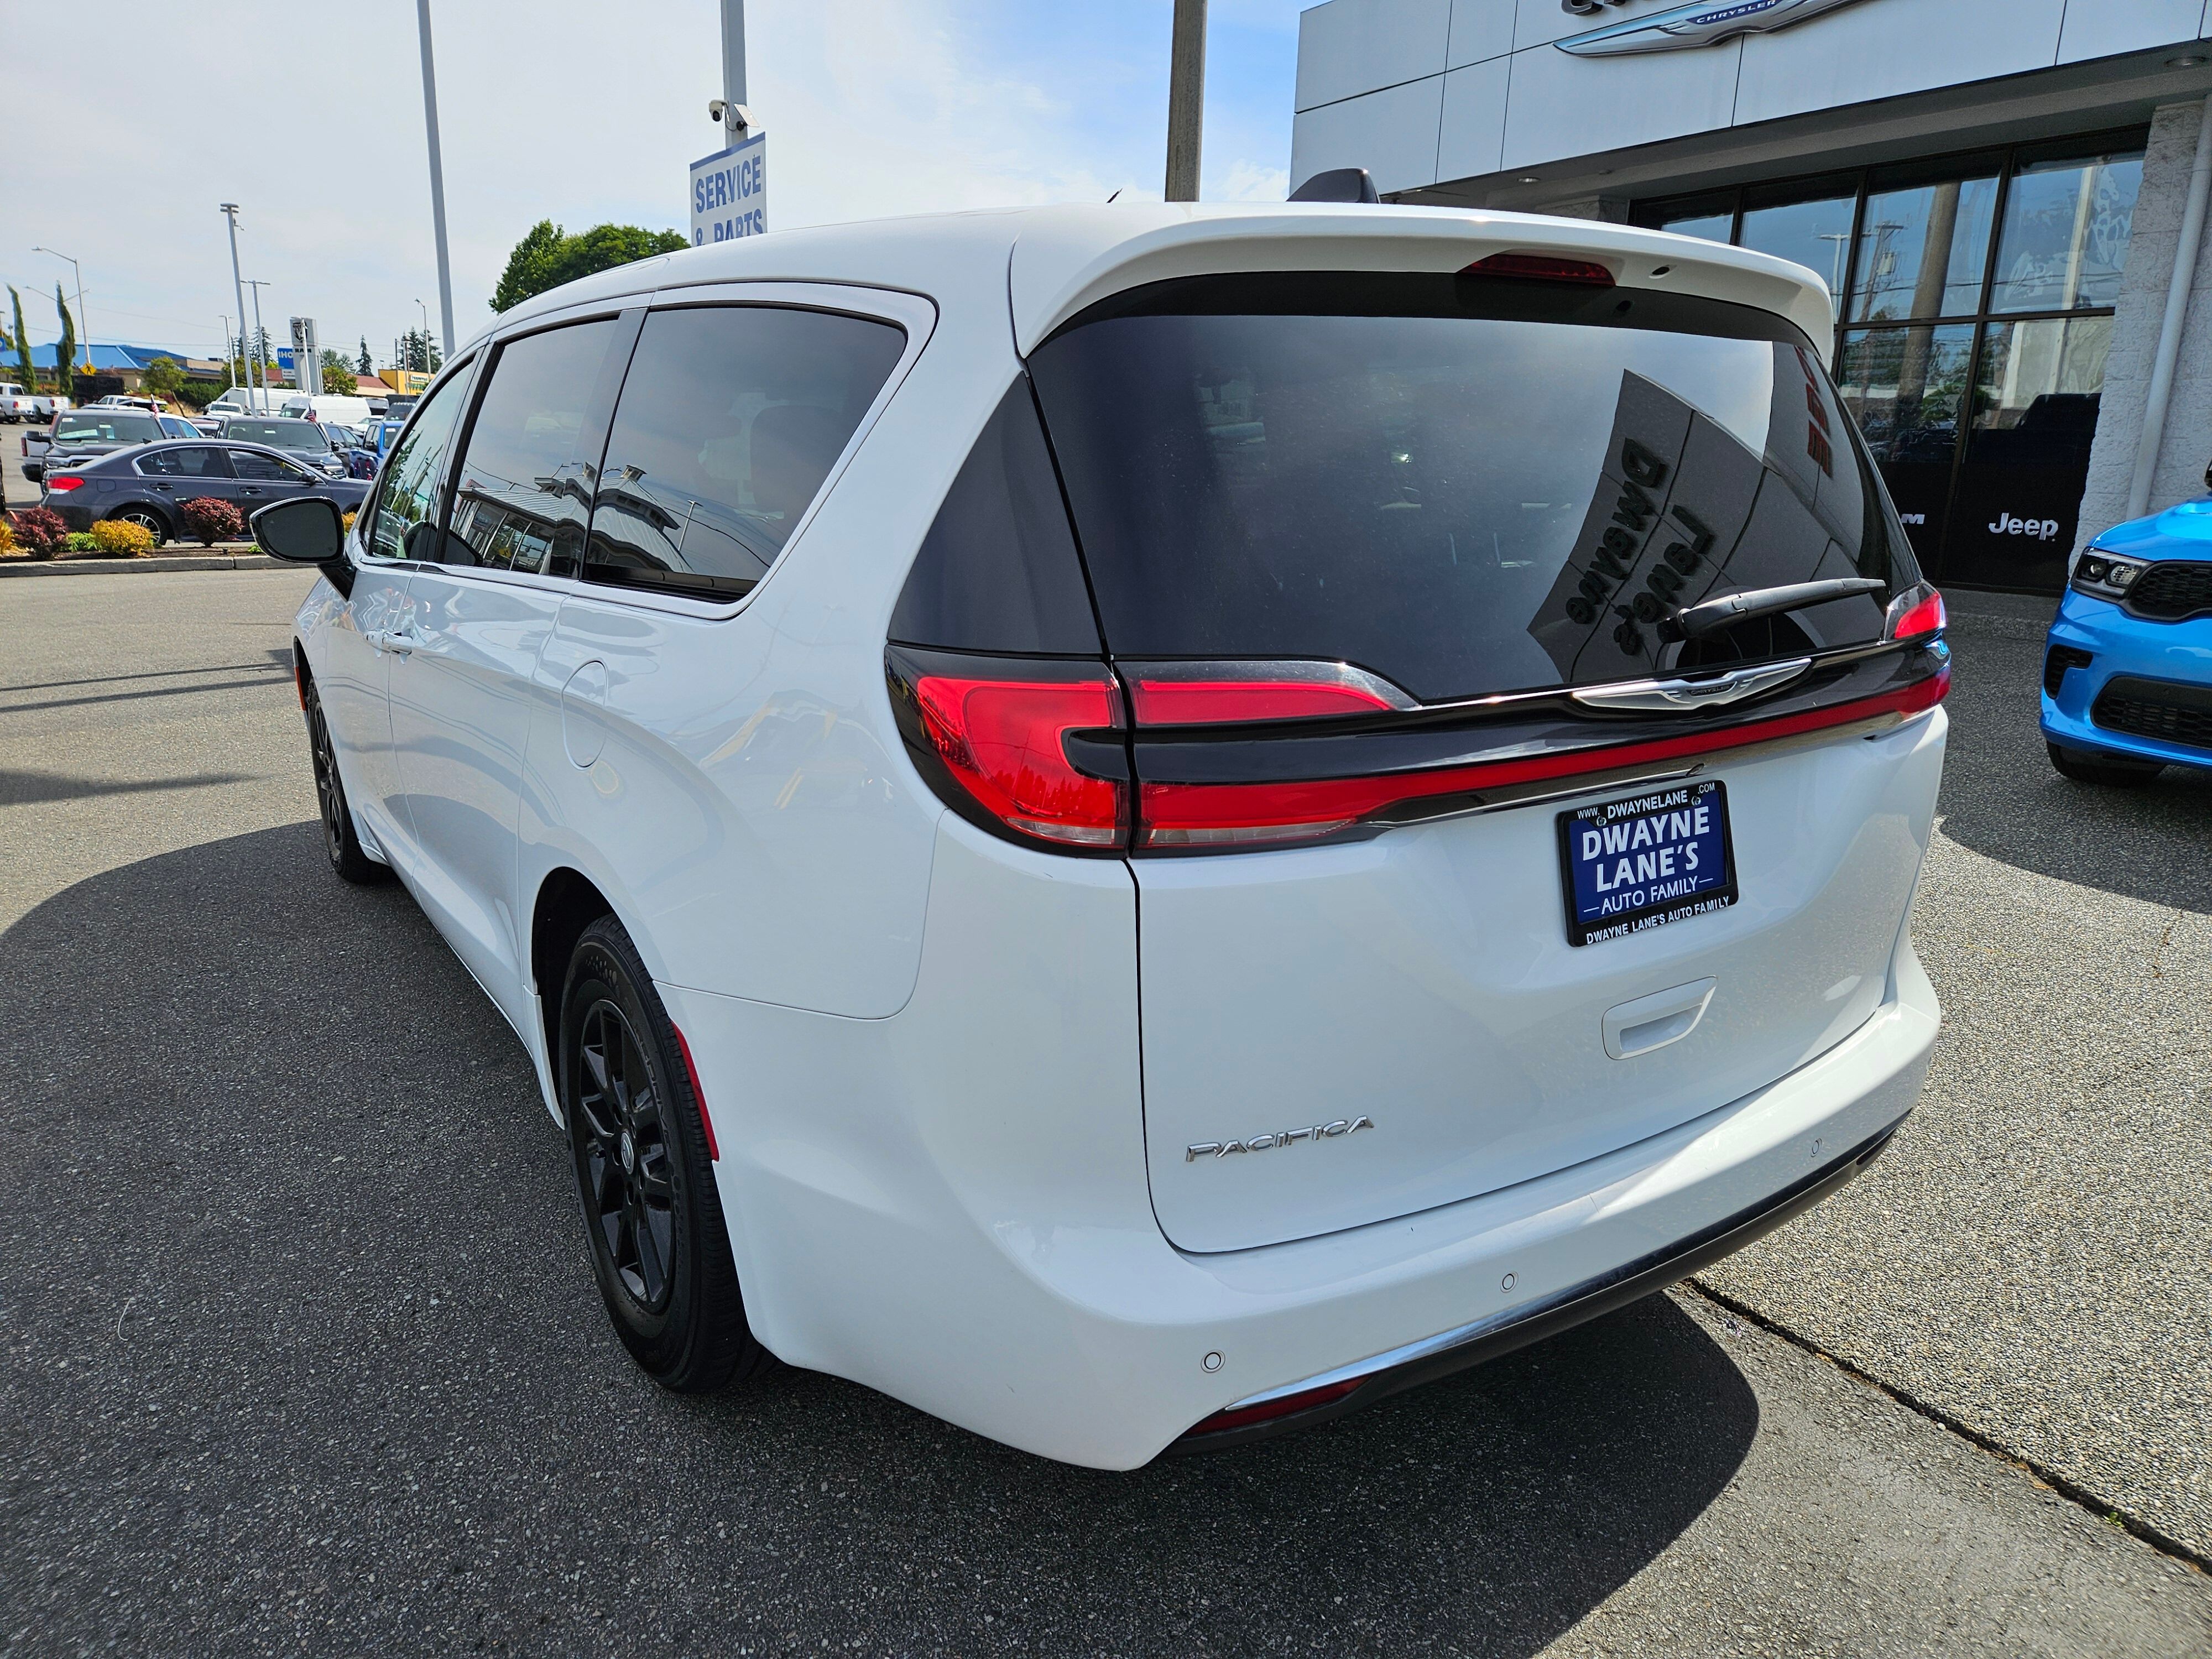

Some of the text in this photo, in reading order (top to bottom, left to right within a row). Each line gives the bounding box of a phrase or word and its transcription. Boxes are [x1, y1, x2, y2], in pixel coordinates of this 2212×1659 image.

[1696, 0, 1777, 24] CHRYSLER
[696, 156, 761, 213] SERVICE
[714, 208, 763, 242] PARTS
[1988, 513, 2059, 540] Jeep
[1608, 790, 1688, 818] DWAYNELANE
[1583, 806, 1710, 861] DWAYNE
[1597, 842, 1699, 893] LANE'S
[1601, 875, 1698, 915] AUTO FAMILY
[1586, 896, 1729, 945] DWAYNE LANE'S AUTO FAMILY
[1186, 1115, 1374, 1162] PACIFICA
